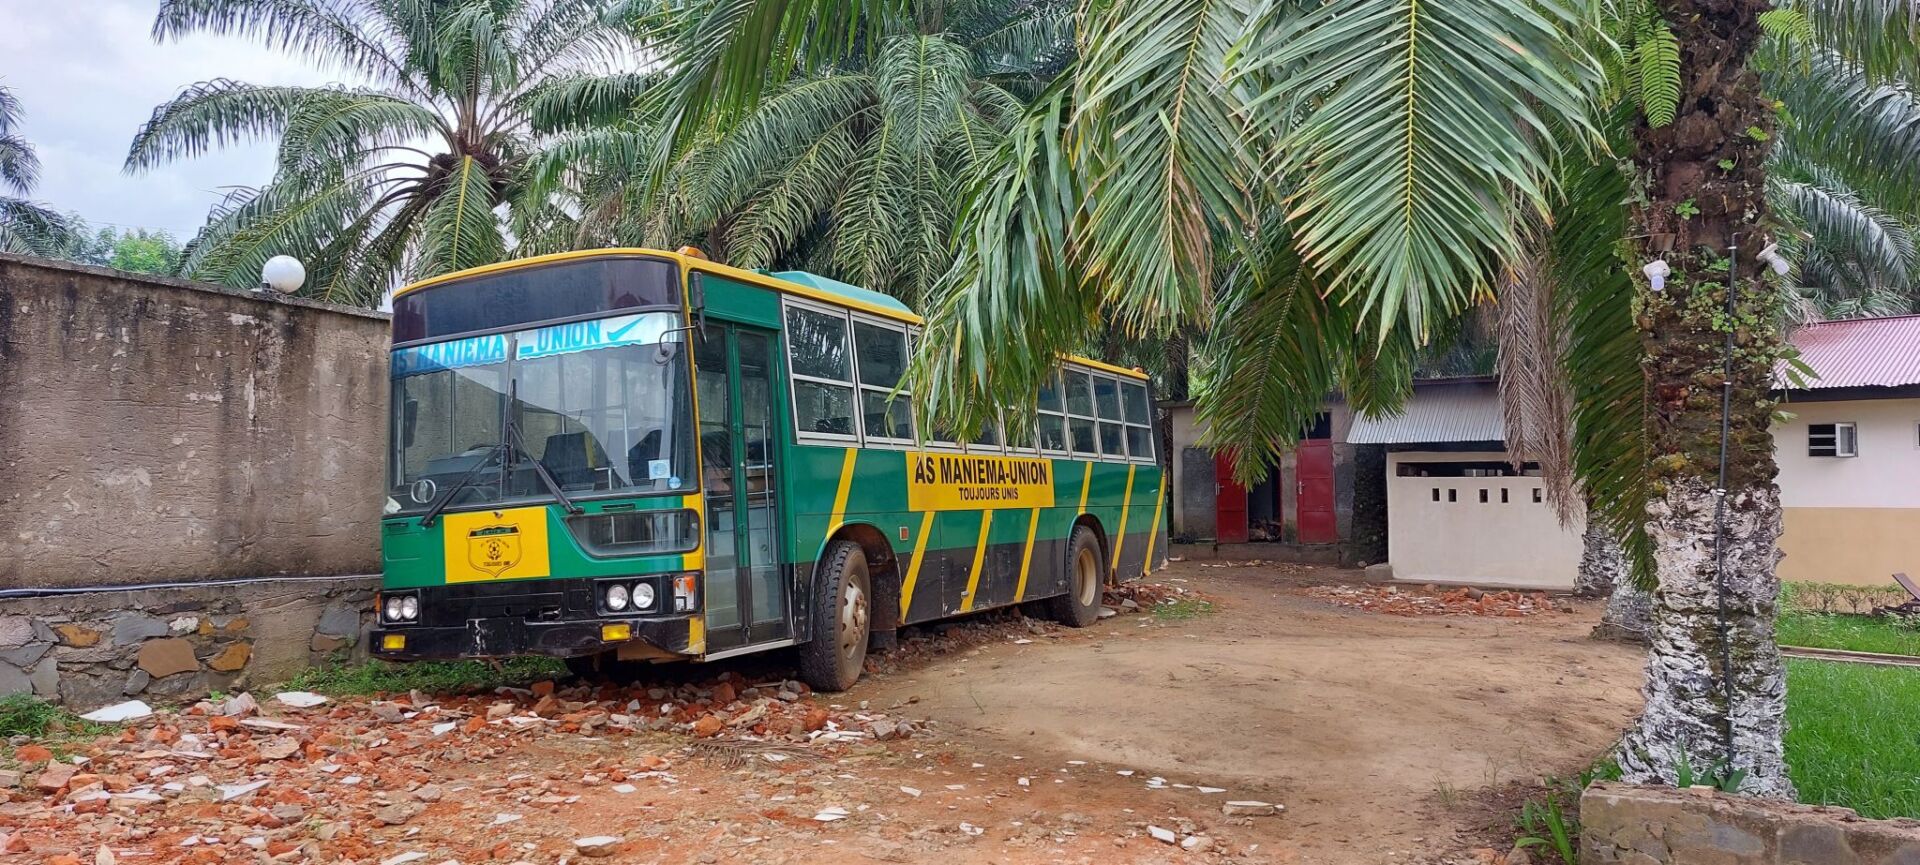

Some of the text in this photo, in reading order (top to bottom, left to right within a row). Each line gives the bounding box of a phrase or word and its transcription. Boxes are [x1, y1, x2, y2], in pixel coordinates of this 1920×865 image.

[417, 333, 506, 370] MANIEMA
[915, 456, 1047, 485] AS MANIEMA-UNION
[959, 487, 1018, 500] TOUJOURS UNIS
